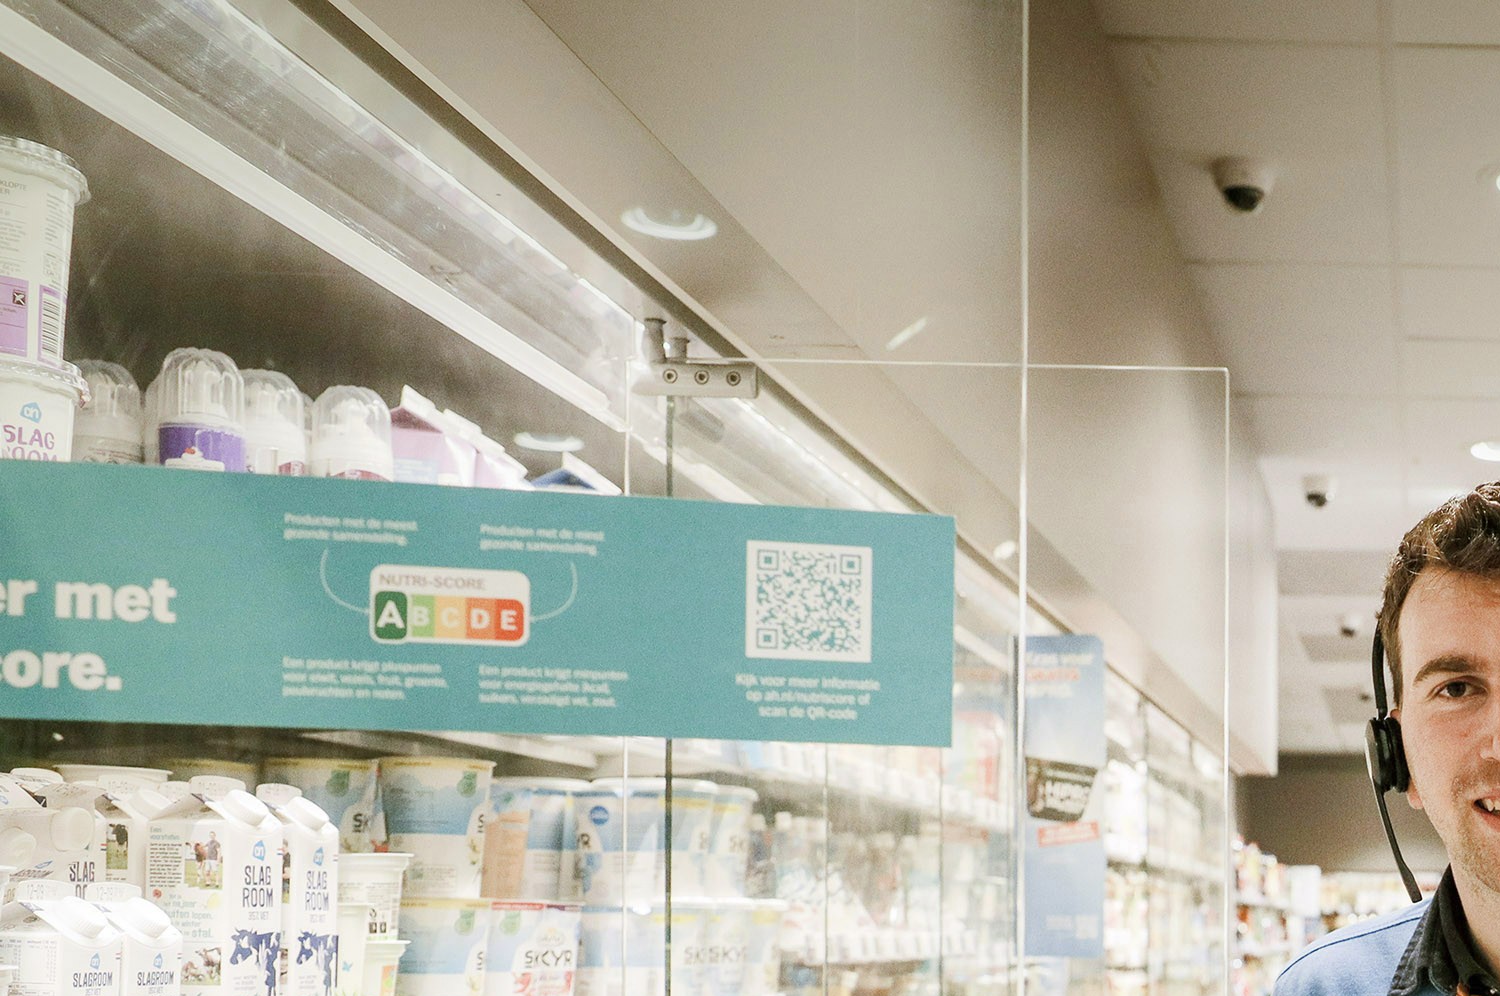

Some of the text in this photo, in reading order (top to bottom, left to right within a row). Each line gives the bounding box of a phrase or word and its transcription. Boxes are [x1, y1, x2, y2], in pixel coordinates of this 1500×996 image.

[3, 424, 55, 450] SLAG
[378, 573, 486, 591] NUTRI-SCORE
[0, 578, 177, 623] r met
[0, 650, 123, 691] ore.
[69, 861, 95, 882] SLAG
[244, 865, 272, 886] SLAG
[306, 870, 328, 890] SLAG
[242, 887, 273, 908] ROOM
[305, 891, 330, 911] ROOM
[72, 972, 113, 988] SLAGROOM
[136, 971, 174, 986] SLAGROOM
